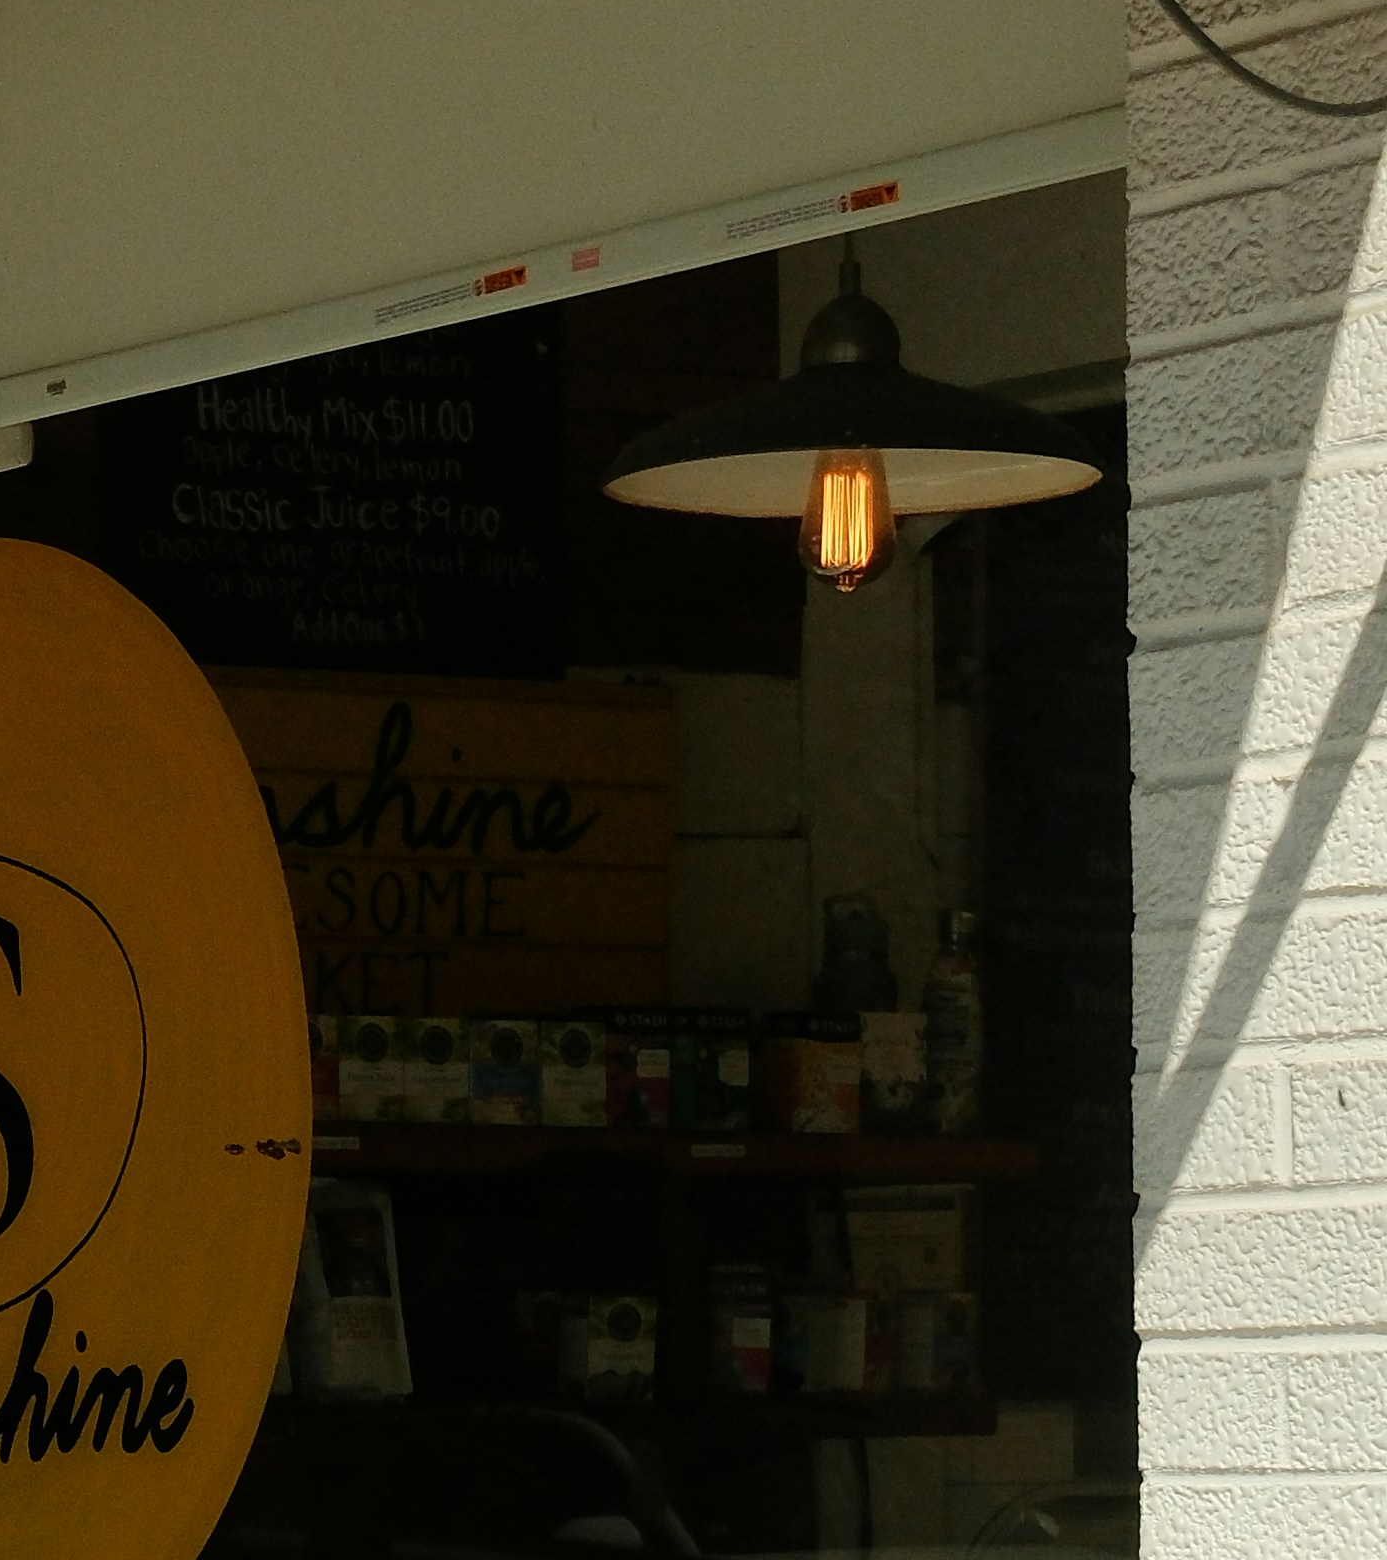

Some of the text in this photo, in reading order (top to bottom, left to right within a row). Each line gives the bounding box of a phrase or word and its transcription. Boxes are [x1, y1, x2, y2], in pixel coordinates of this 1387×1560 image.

[197, 382, 313, 439] Healthy
[323, 395, 380, 439] Mix
[173, 482, 293, 533] Classic
[307, 484, 399, 530] Juice
